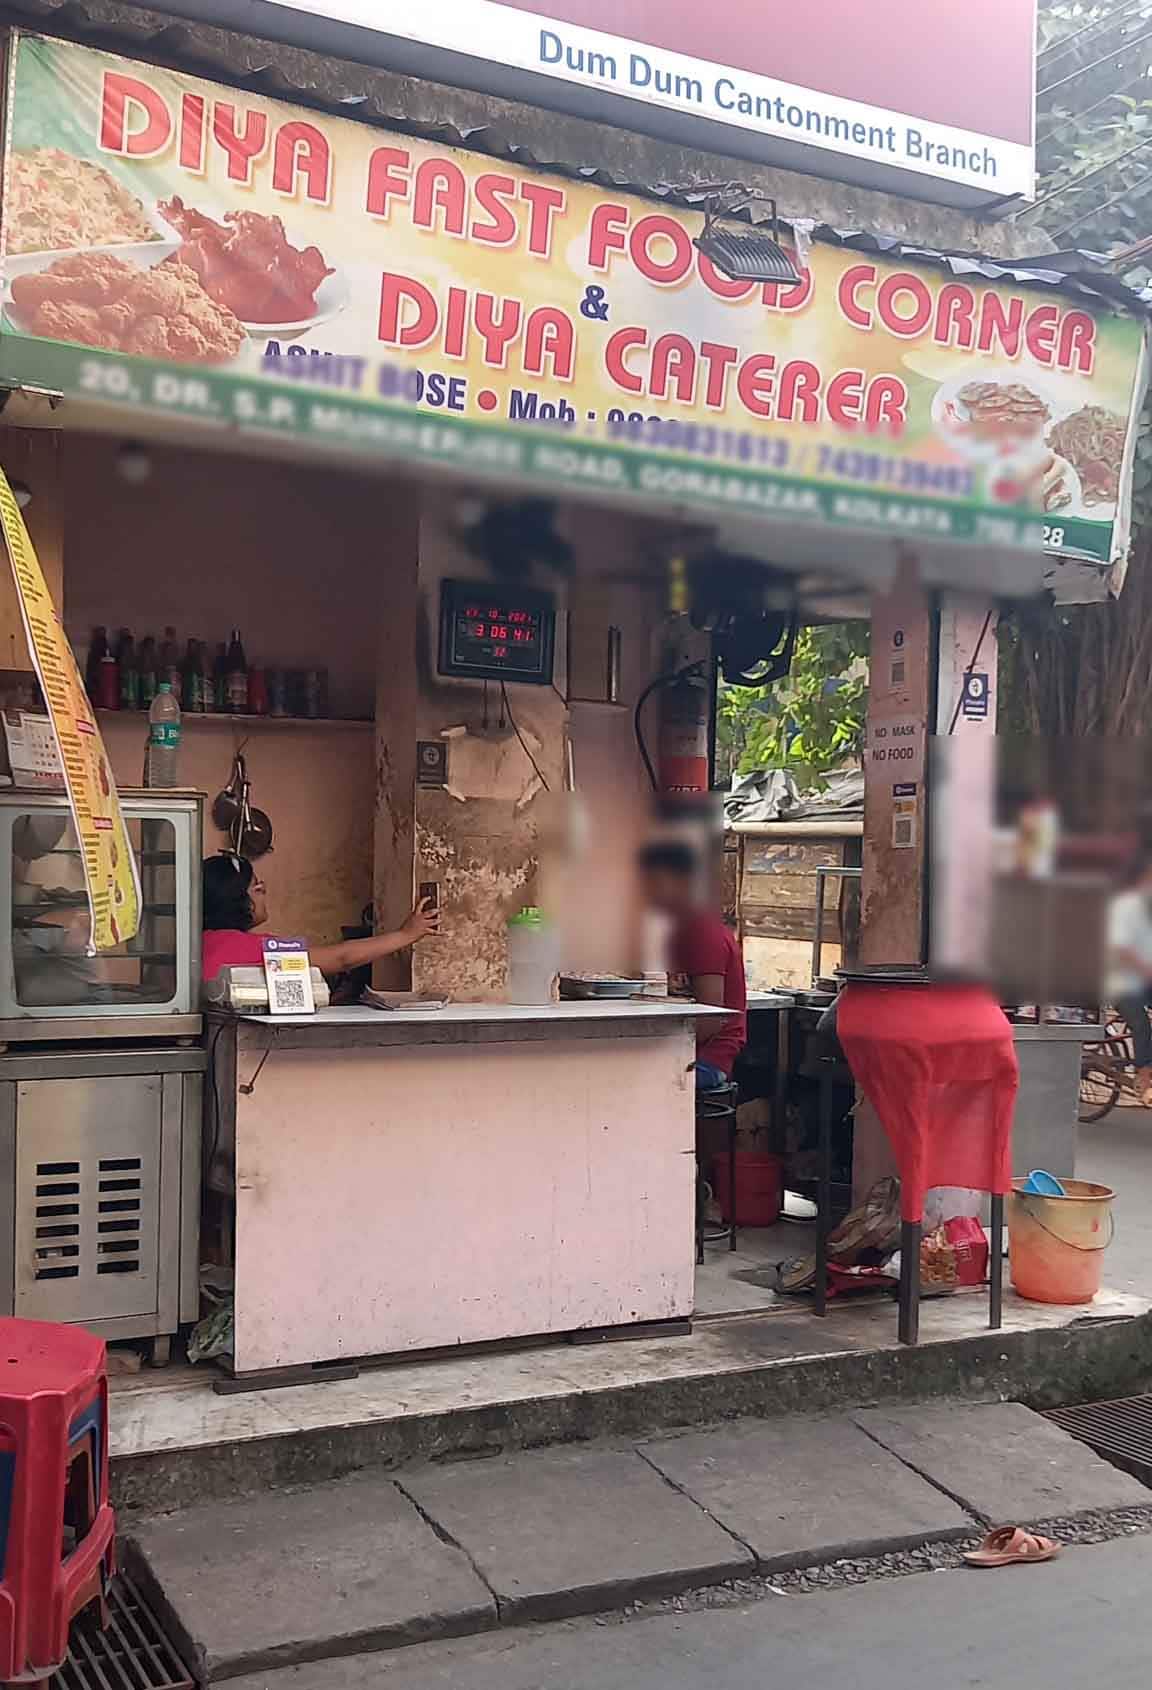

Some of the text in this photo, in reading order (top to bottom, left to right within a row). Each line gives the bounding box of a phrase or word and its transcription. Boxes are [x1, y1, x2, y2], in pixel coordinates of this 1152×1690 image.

[540, 29, 997, 177] Dum Dum Cantonment Branch
[99, 71, 331, 203] DIYA
[365, 146, 565, 256] FAST
[837, 264, 1097, 373] CORNER
[580, 285, 609, 321] &
[377, 271, 574, 378] DIYA
[604, 326, 907, 440] CATERER
[872, 747, 914, 761] NO FOOD
[875, 725, 915, 738] NO MASK
